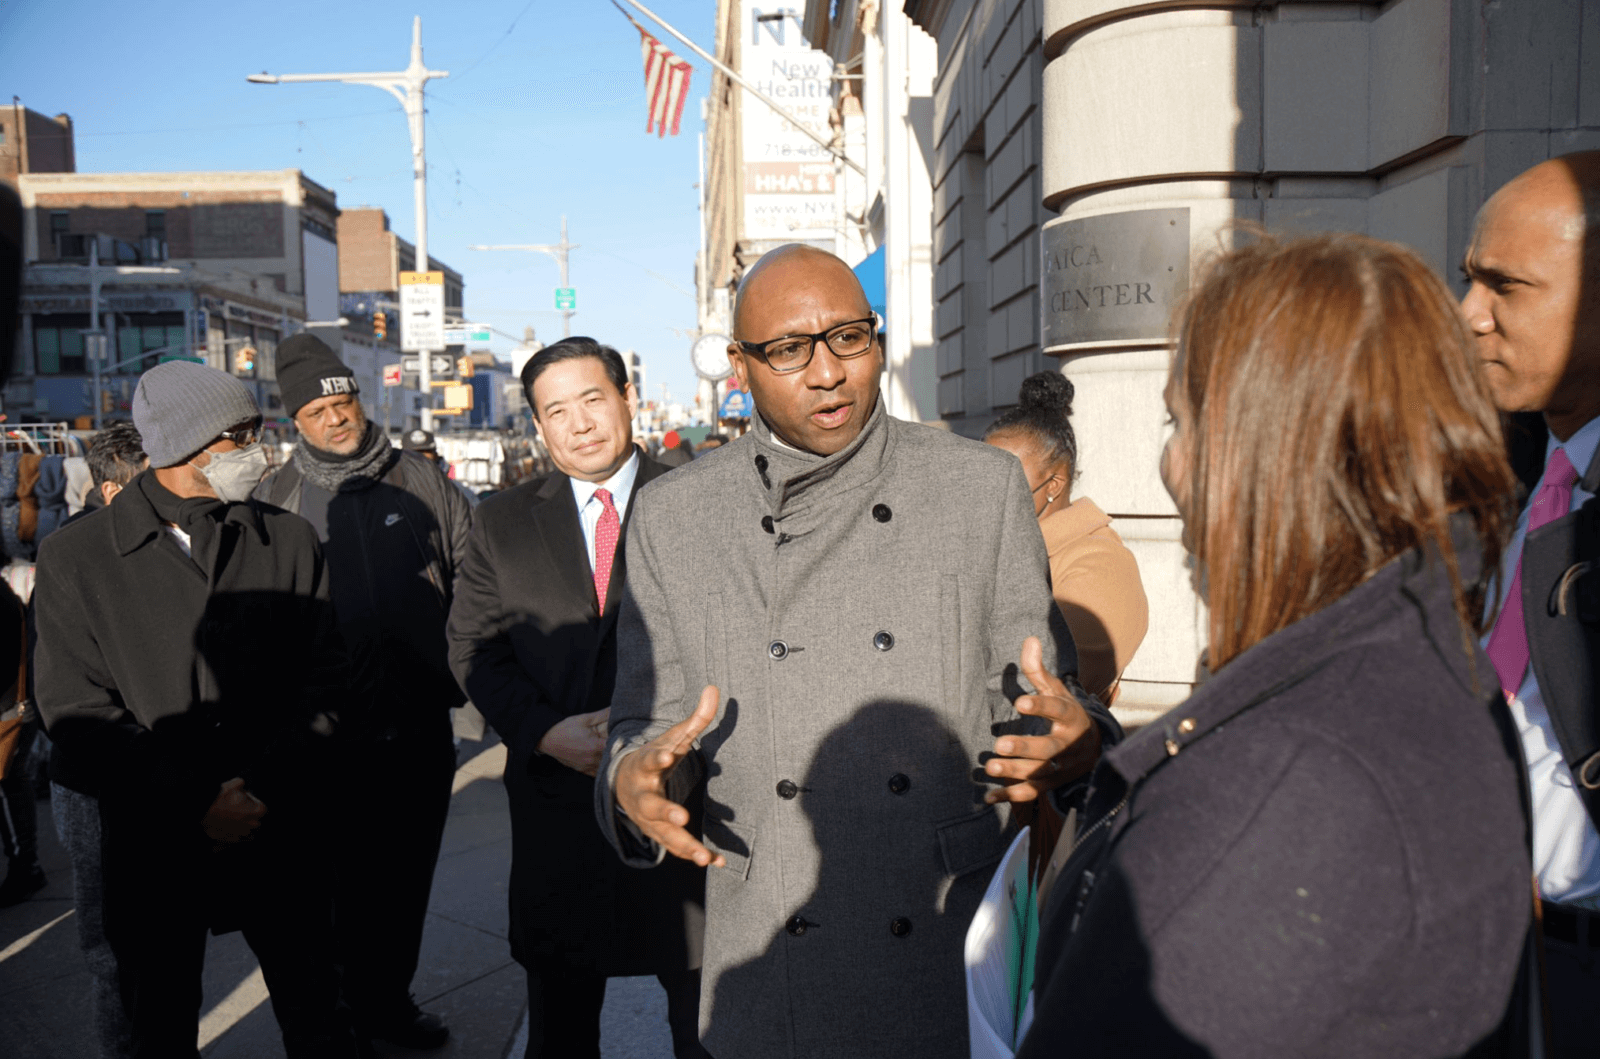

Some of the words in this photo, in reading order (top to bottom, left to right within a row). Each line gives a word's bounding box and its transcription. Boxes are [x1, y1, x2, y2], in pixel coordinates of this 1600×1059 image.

[771, 58, 820, 77] New
[757, 80, 829, 98] Health
[769, 104, 819, 117] OME
[1051, 282, 1155, 313] CENTER
